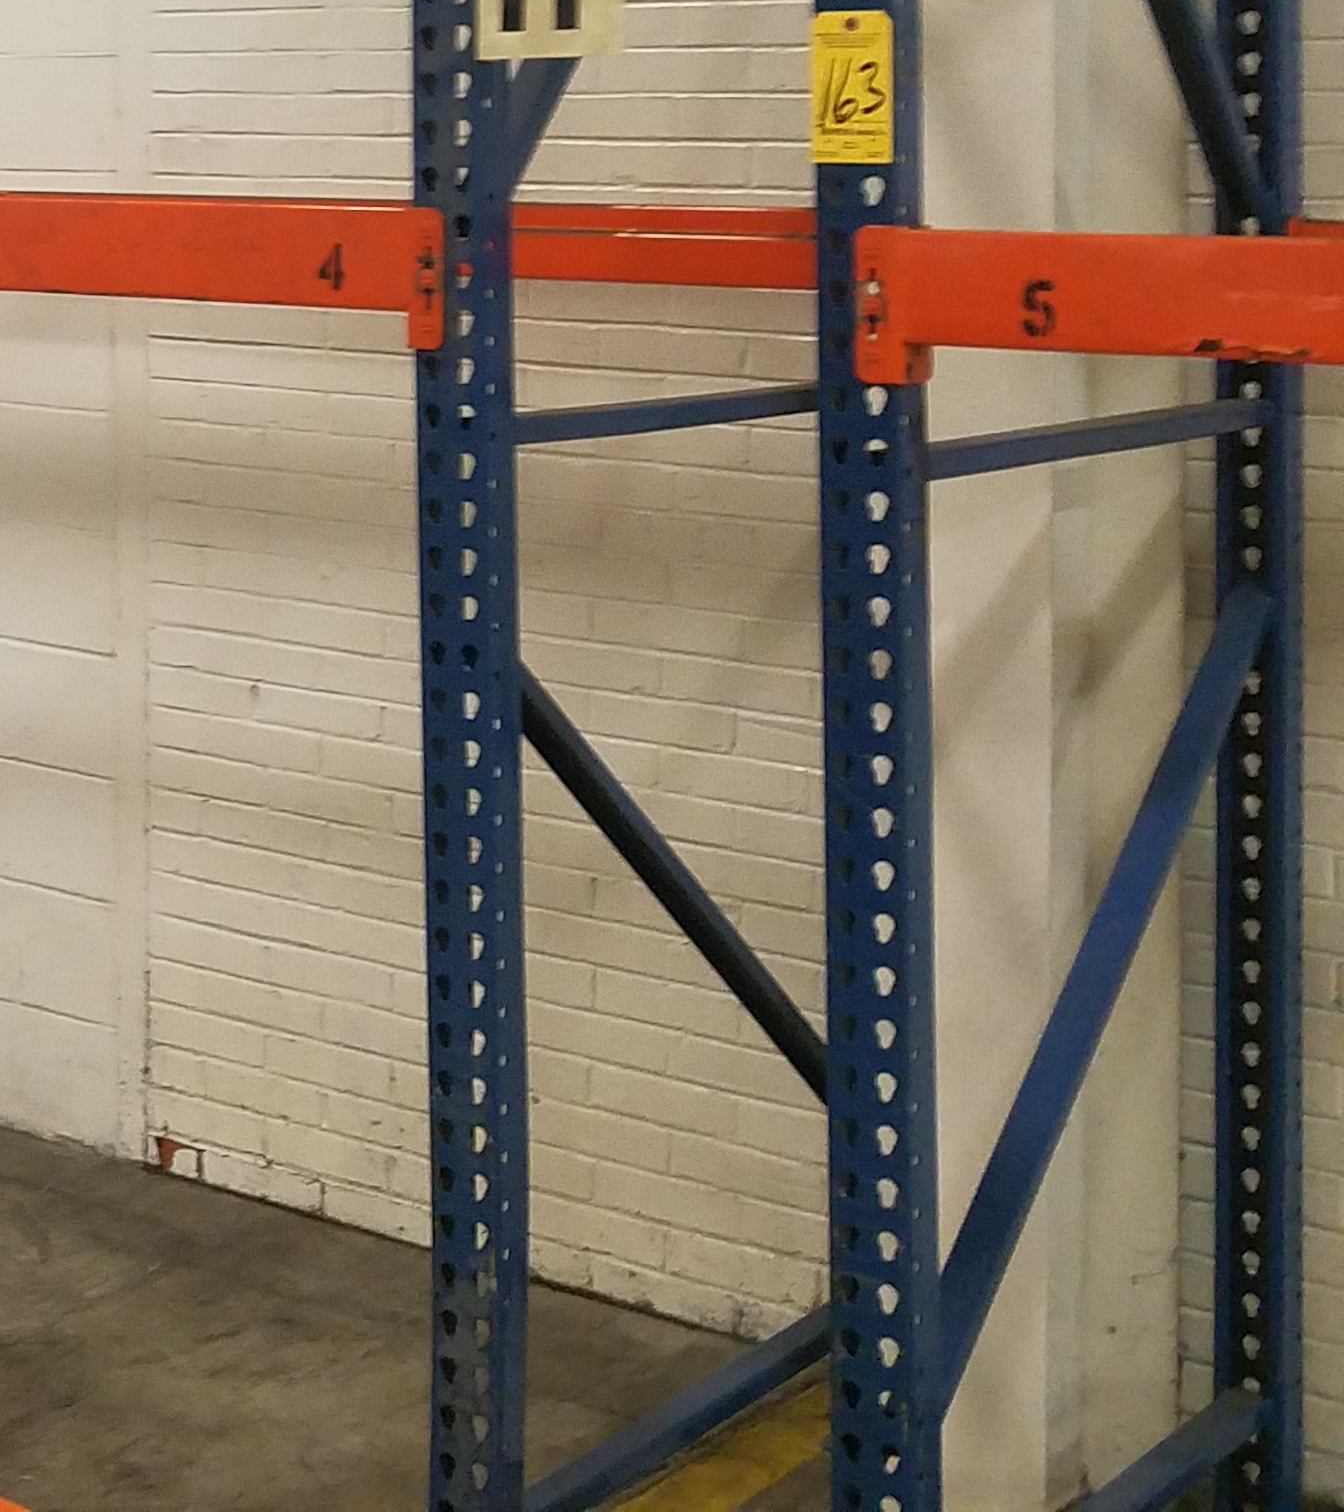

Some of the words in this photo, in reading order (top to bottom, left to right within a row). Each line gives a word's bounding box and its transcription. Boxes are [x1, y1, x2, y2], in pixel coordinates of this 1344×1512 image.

[817, 57, 888, 124] 163
[317, 242, 345, 291] 4
[1023, 279, 1056, 337] 5
